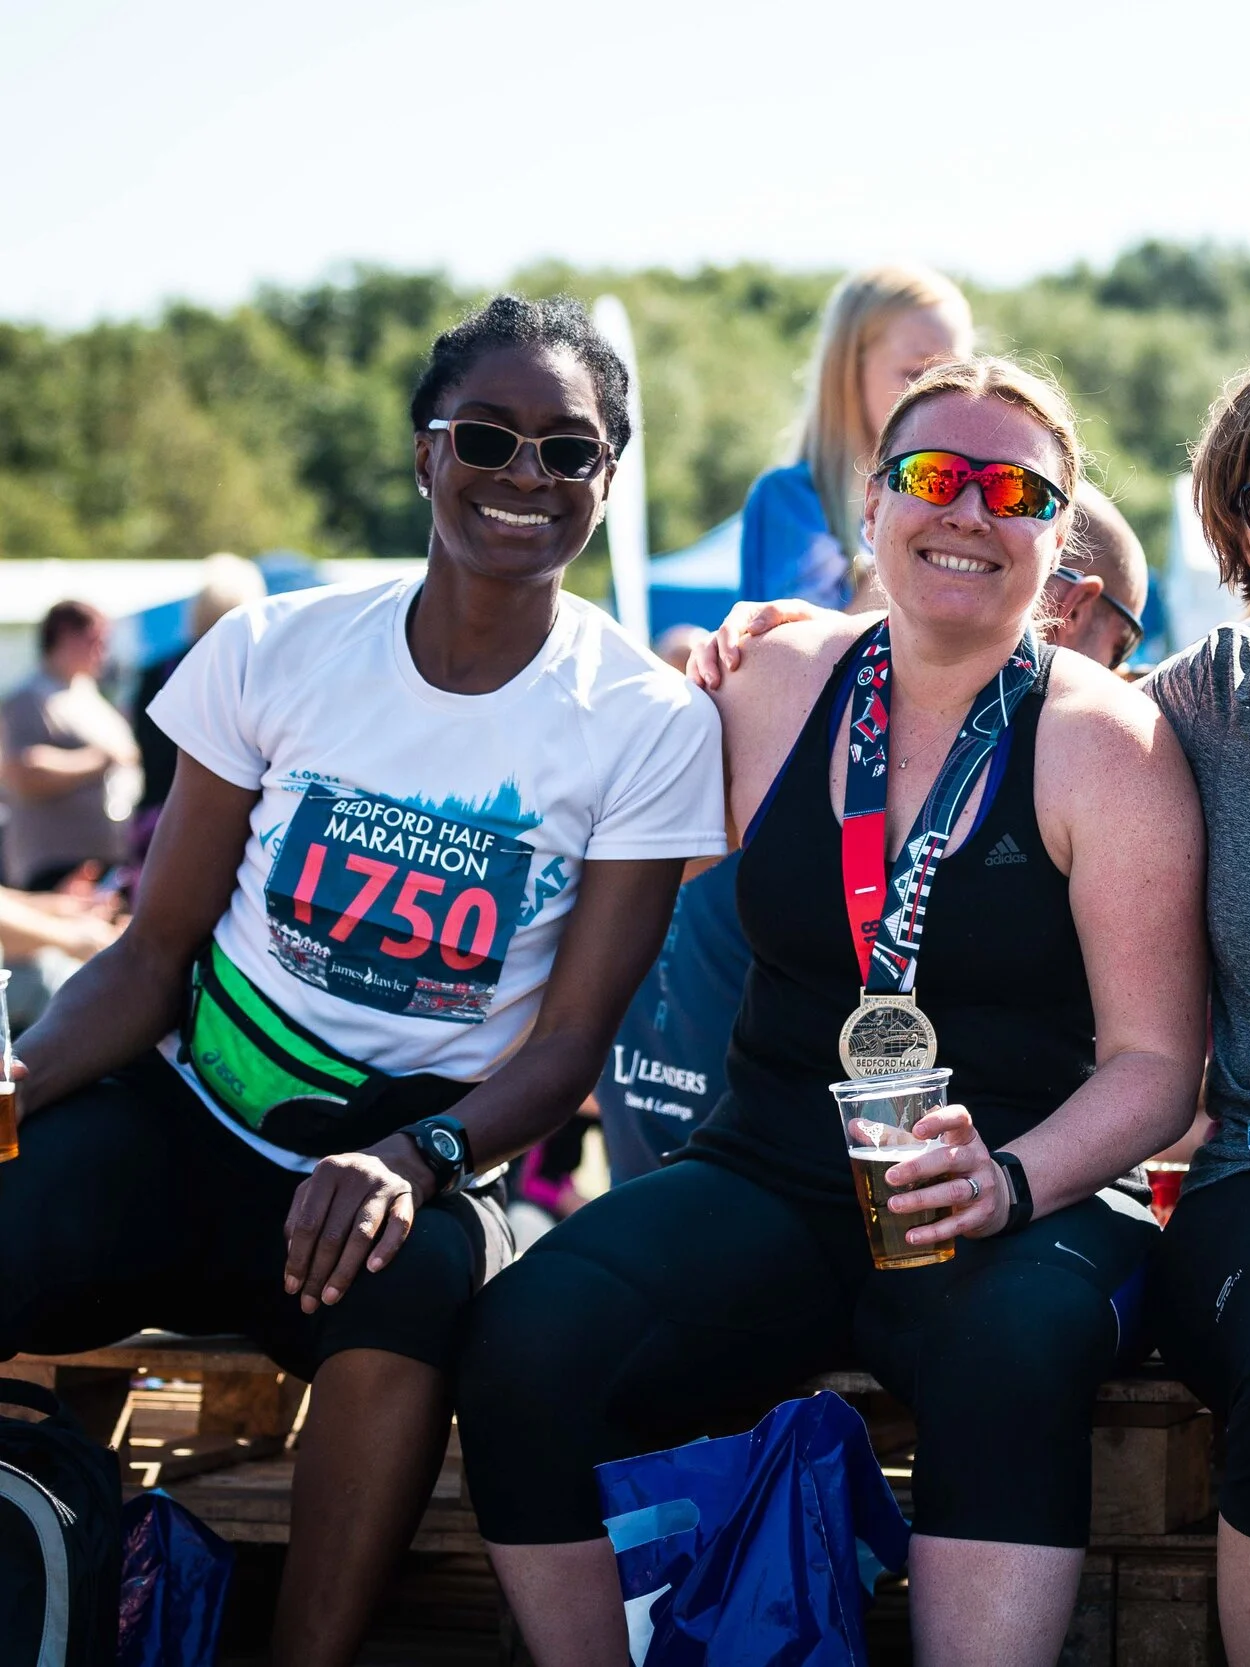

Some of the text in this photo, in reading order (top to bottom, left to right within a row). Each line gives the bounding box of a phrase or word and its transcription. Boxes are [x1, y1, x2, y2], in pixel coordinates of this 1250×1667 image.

[332, 800, 495, 852] BEDFORD HALF
[323, 814, 489, 881] MARATHON
[984, 852, 1028, 867] adidas
[291, 842, 498, 971] 1750
[329, 961, 364, 980] james
[373, 973, 410, 993] lawler
[638, 1058, 707, 1096] LEADERS
[856, 1058, 921, 1068] BEDFORD HALF
